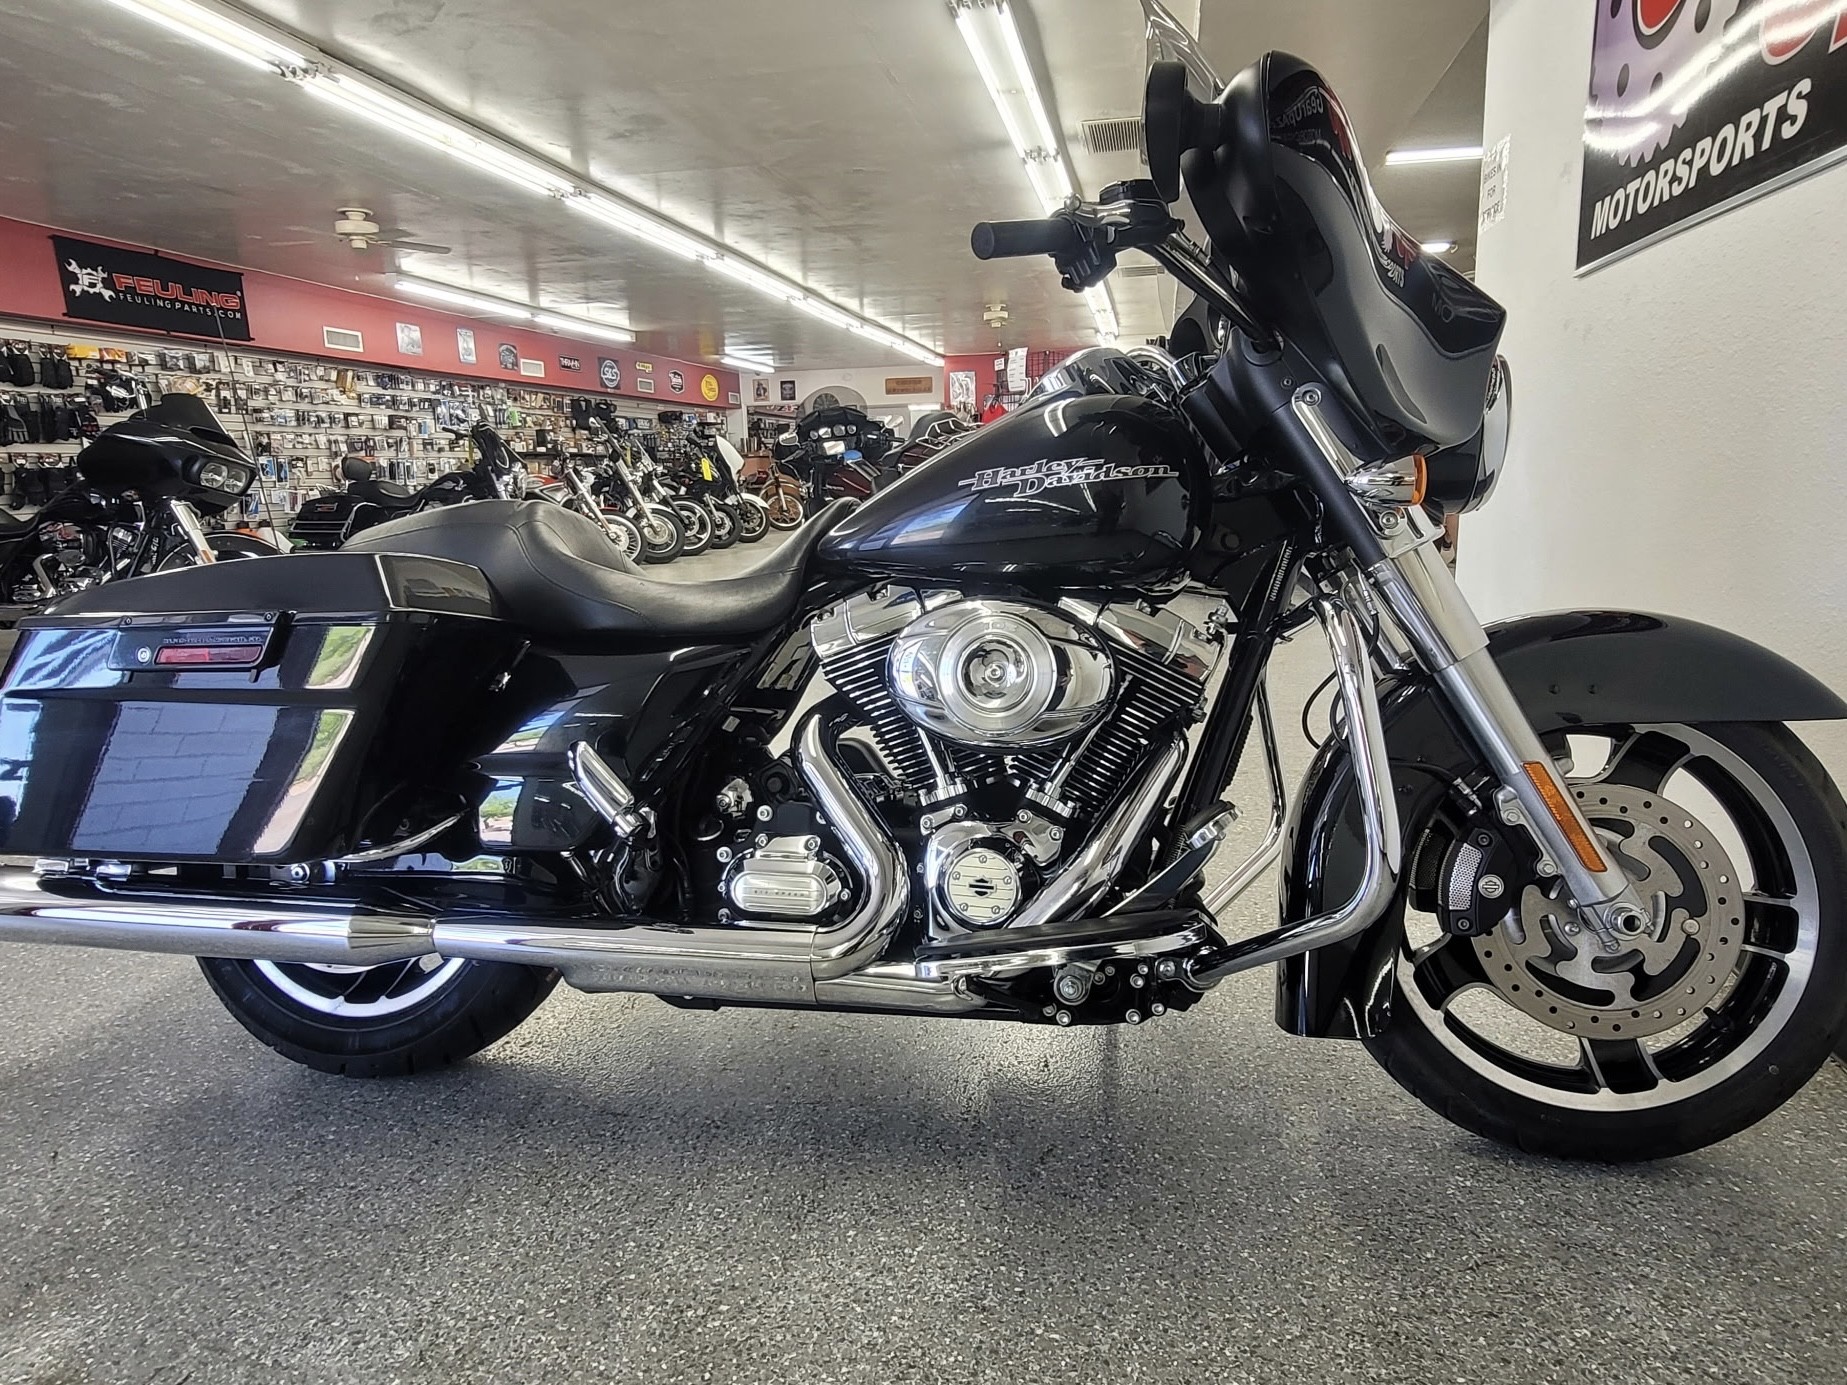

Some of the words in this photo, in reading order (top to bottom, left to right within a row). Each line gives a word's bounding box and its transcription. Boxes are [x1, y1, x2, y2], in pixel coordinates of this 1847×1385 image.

[1590, 77, 1812, 240] MOTORSPORTS
[112, 273, 240, 310] FEULING
[603, 366, 618, 380] S&S
[963, 457, 1104, 491] Harley
[1002, 463, 1179, 498] Davidson
